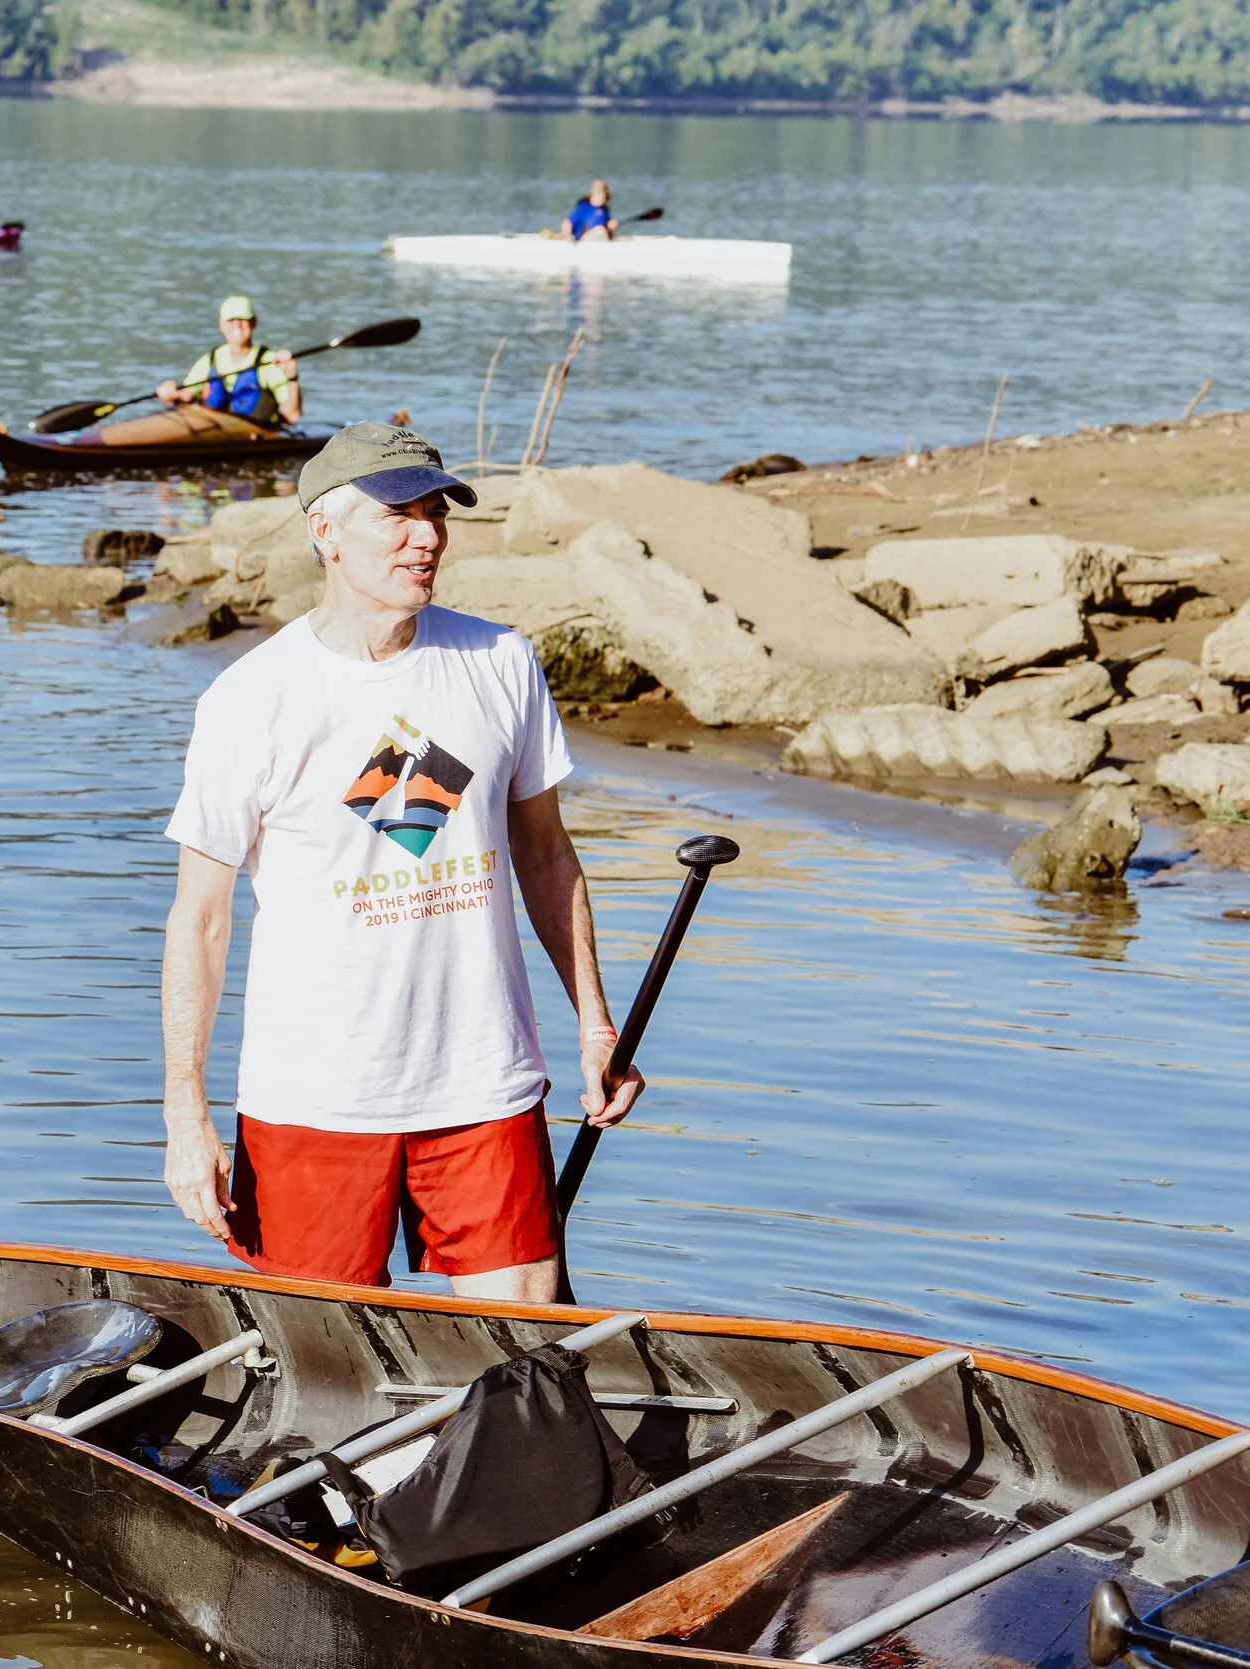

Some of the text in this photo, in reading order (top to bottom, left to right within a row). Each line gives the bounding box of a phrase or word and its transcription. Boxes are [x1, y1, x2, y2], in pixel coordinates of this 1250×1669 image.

[333, 849, 498, 899] PADDLEFEST
[352, 878, 495, 914] ON THE MIGHTY OHIO
[365, 912, 399, 927] 2019
[410, 895, 489, 919] CINCINNATI
